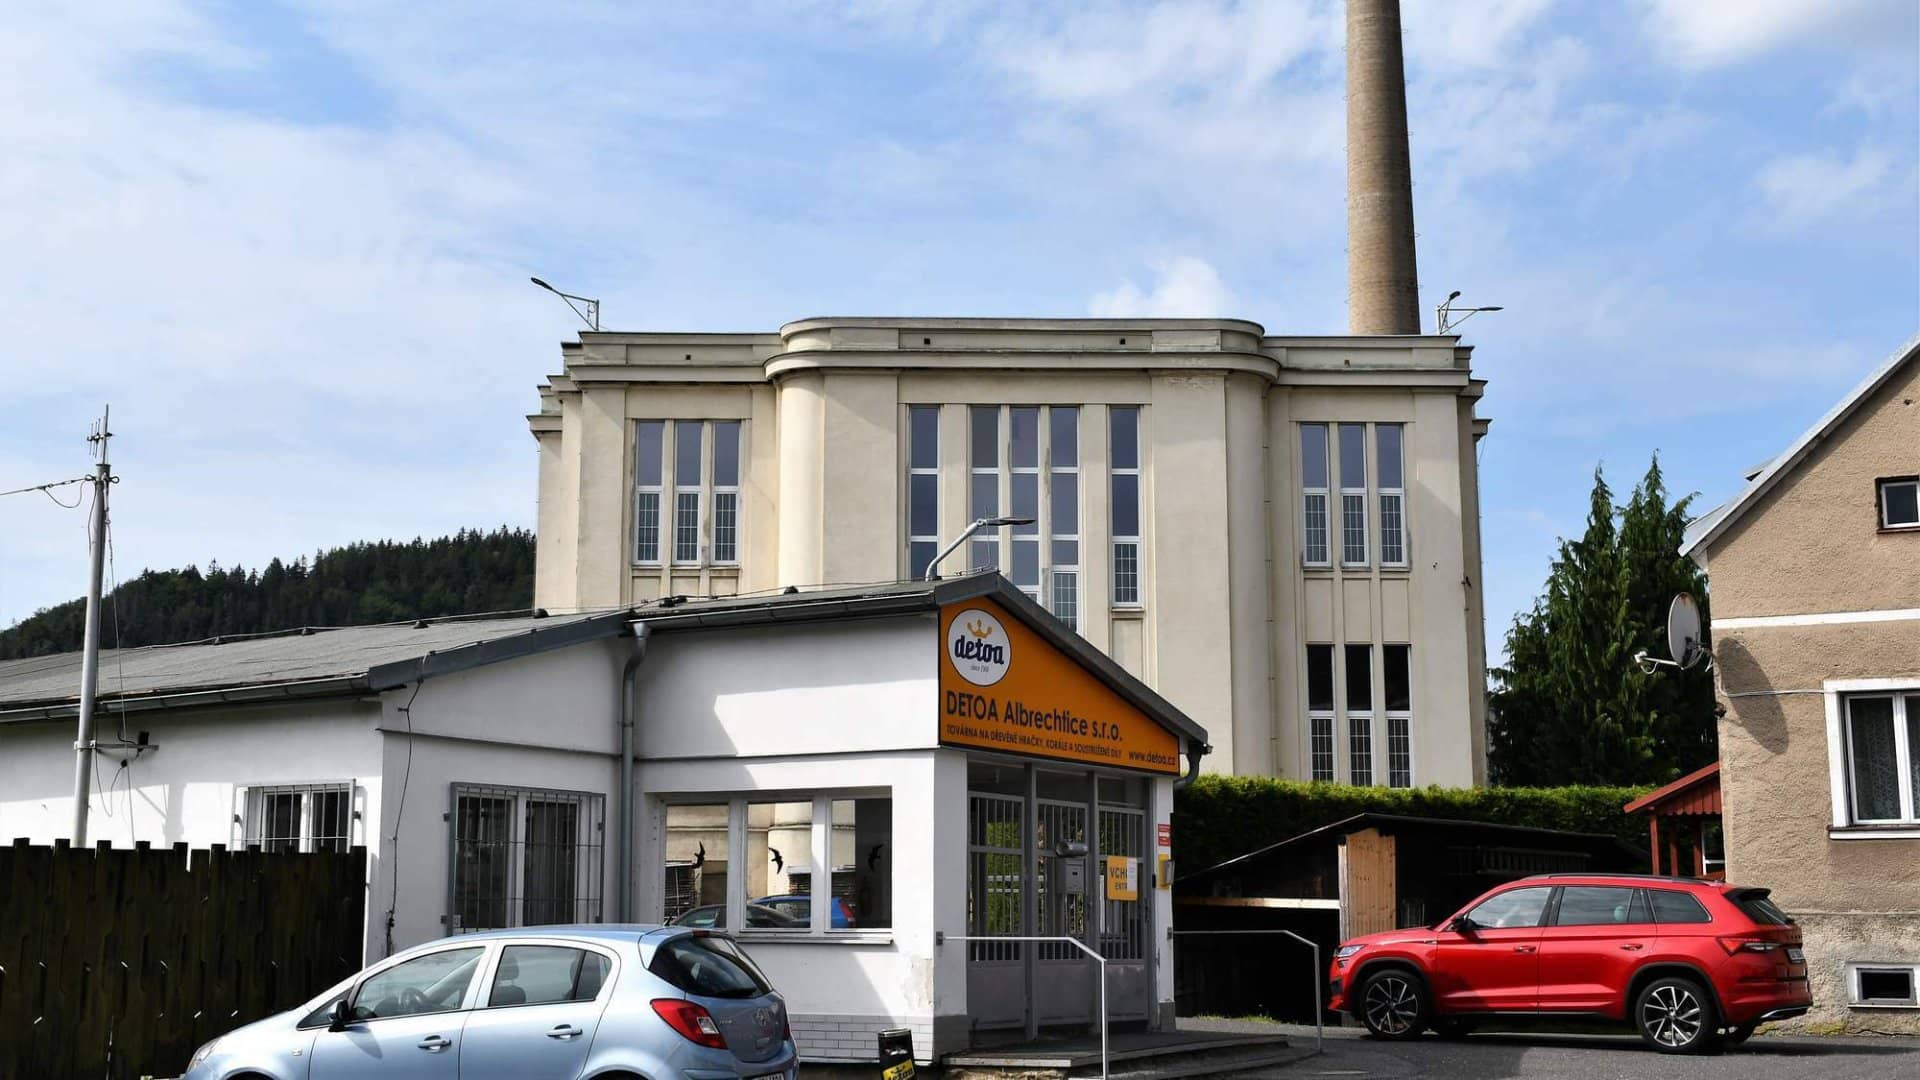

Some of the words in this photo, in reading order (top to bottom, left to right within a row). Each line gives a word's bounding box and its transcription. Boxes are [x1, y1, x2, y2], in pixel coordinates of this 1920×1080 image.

[954, 634, 1004, 665] detoa
[946, 690, 999, 721] DETOA
[1004, 701, 1088, 736] Albrechtice
[1092, 721, 1123, 742] s.r.o.
[946, 724, 978, 737] TOVÁRNA
[979, 729, 989, 740] NA
[1129, 751, 1176, 766] www.detoa.cz
